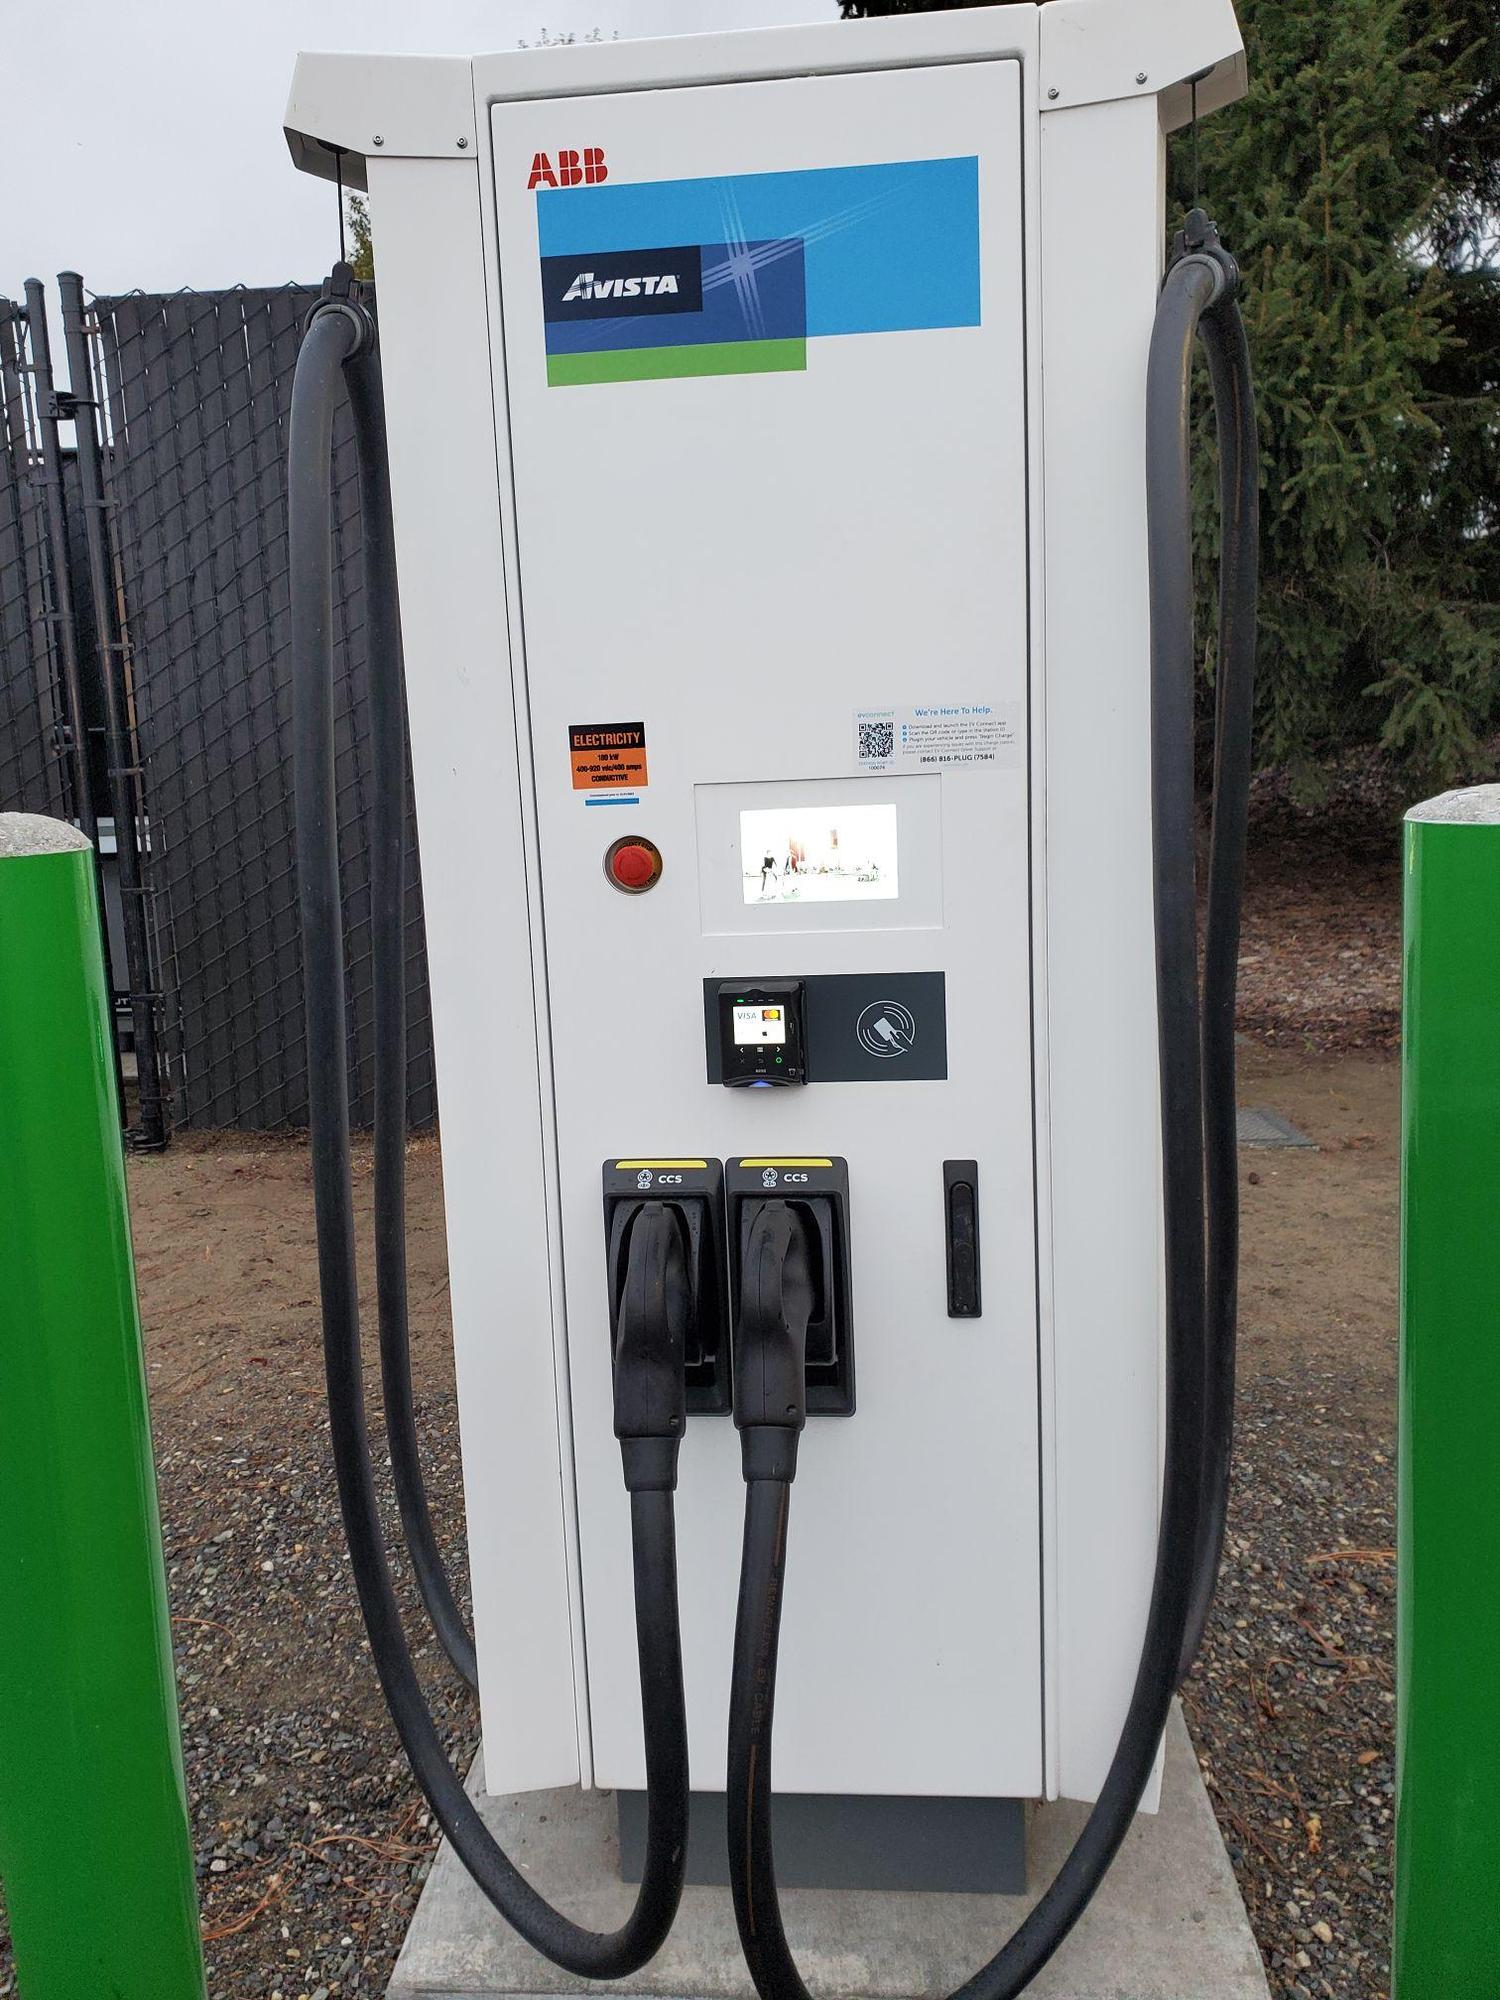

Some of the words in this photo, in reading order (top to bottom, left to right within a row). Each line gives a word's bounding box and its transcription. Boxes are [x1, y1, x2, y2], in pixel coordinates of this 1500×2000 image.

[527, 147, 608, 189] ABB
[561, 272, 677, 301] AVISTA
[915, 708, 939, 717] We're
[940, 707, 959, 716] Here
[961, 706, 970, 715] To
[972, 706, 993, 715] Help.
[573, 732, 640, 747] ELECTRICITY
[591, 774, 629, 782] CONDUCTIVE
[737, 1011, 757, 1020] VISA
[658, 1174, 683, 1184] CCS
[783, 1173, 809, 1183] CCS
